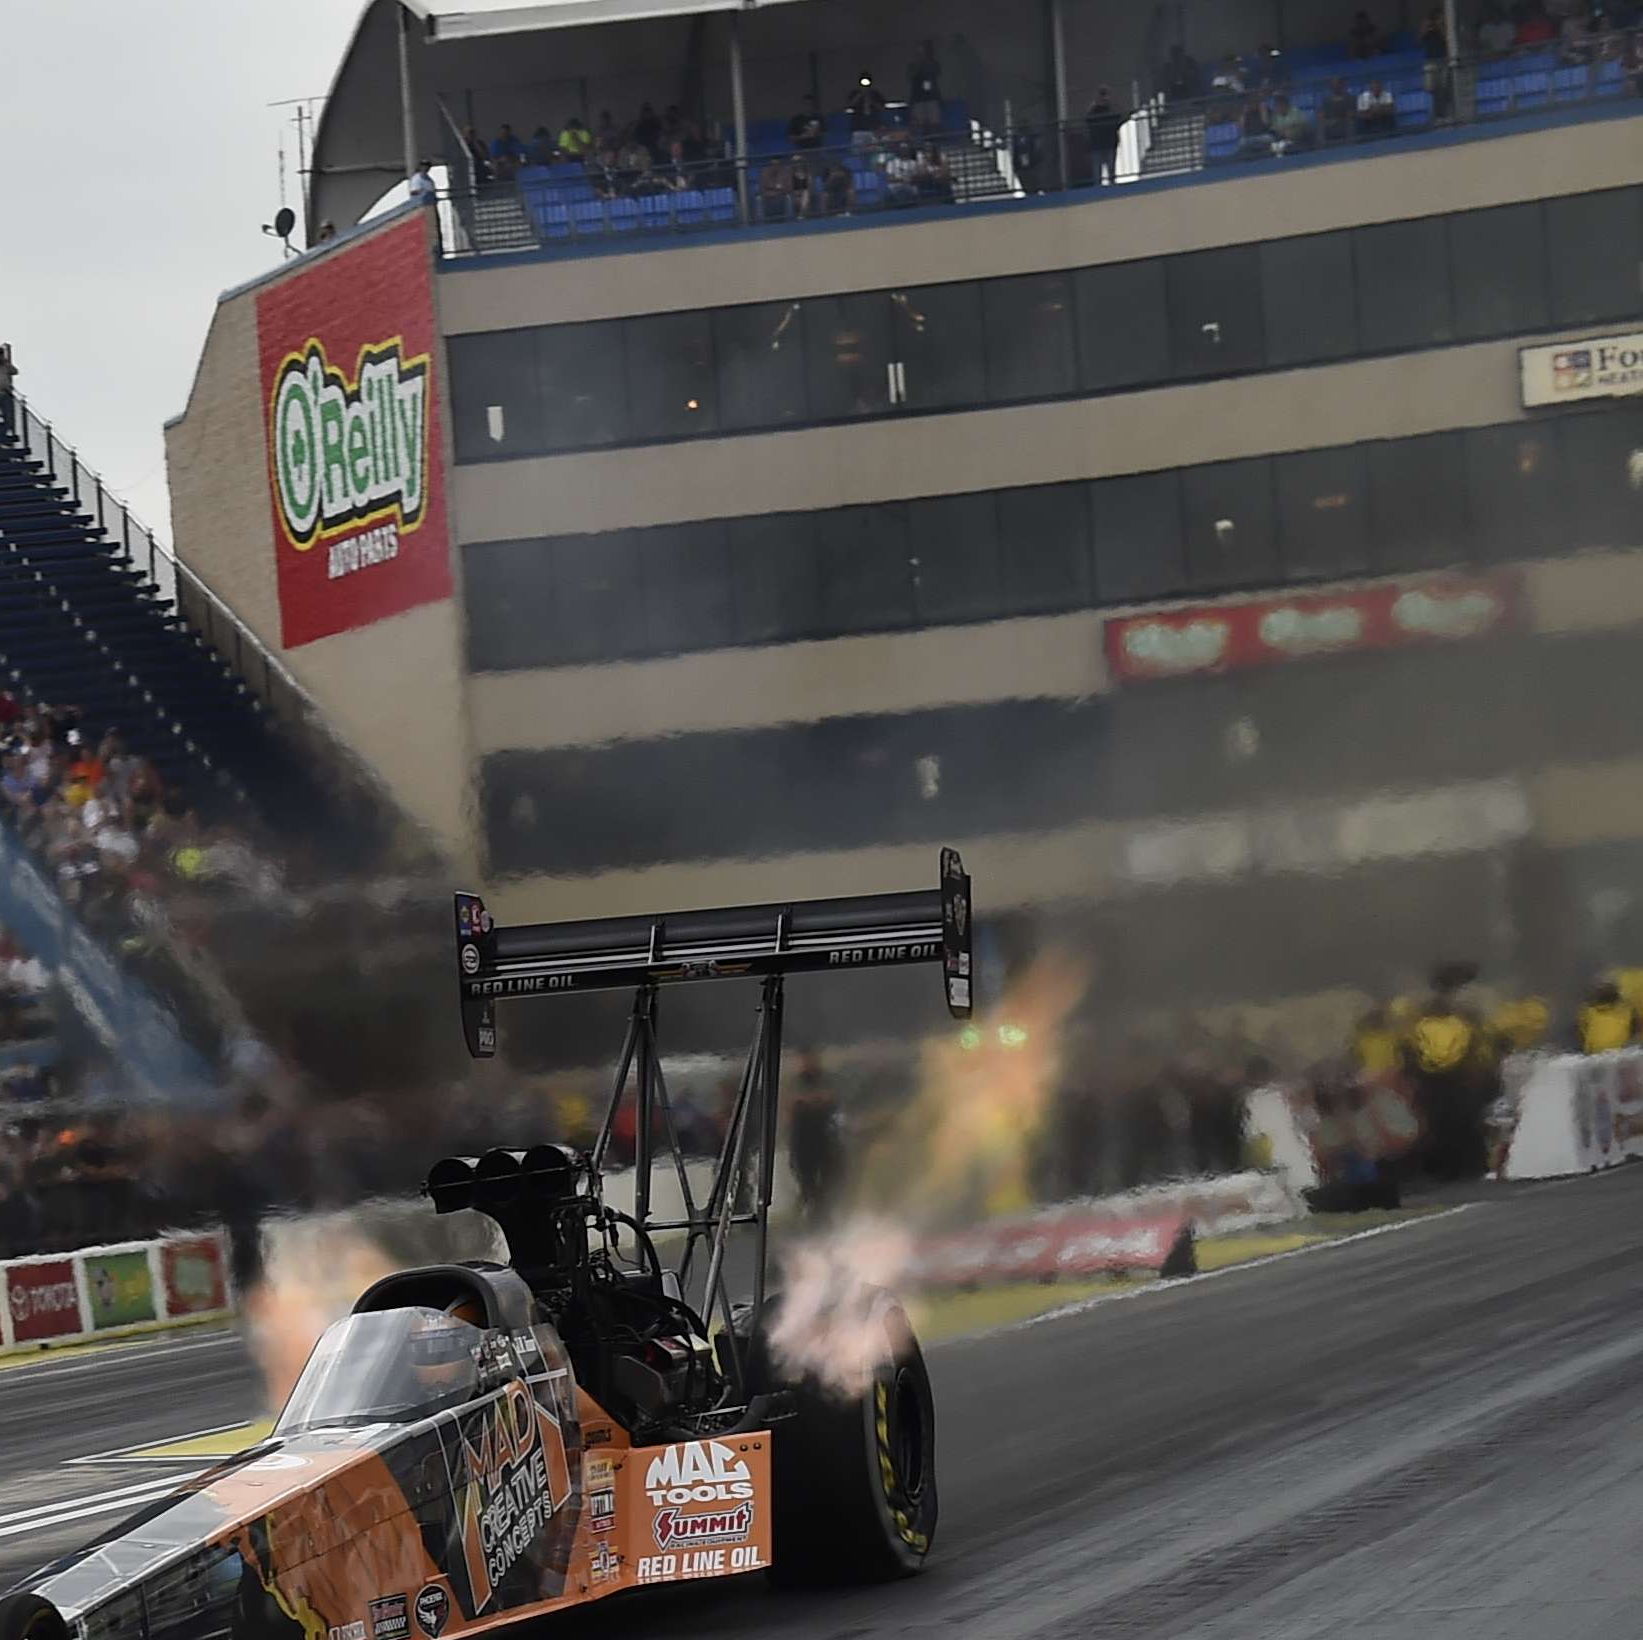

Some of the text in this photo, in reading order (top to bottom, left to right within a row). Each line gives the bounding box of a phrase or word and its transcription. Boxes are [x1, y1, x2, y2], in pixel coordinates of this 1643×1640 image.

[280, 362, 421, 524] O'Reilly
[830, 943, 939, 965] RED LINE OIL
[471, 974, 575, 996] RED LINE OIL
[464, 1376, 536, 1497] MAD
[646, 1441, 751, 1490] MAC
[480, 1447, 547, 1554] CREATIVE
[646, 1482, 754, 1506] TOOLS
[488, 1489, 553, 1587] CONCEPTS
[638, 1546, 760, 1578] RED LINE OIL
